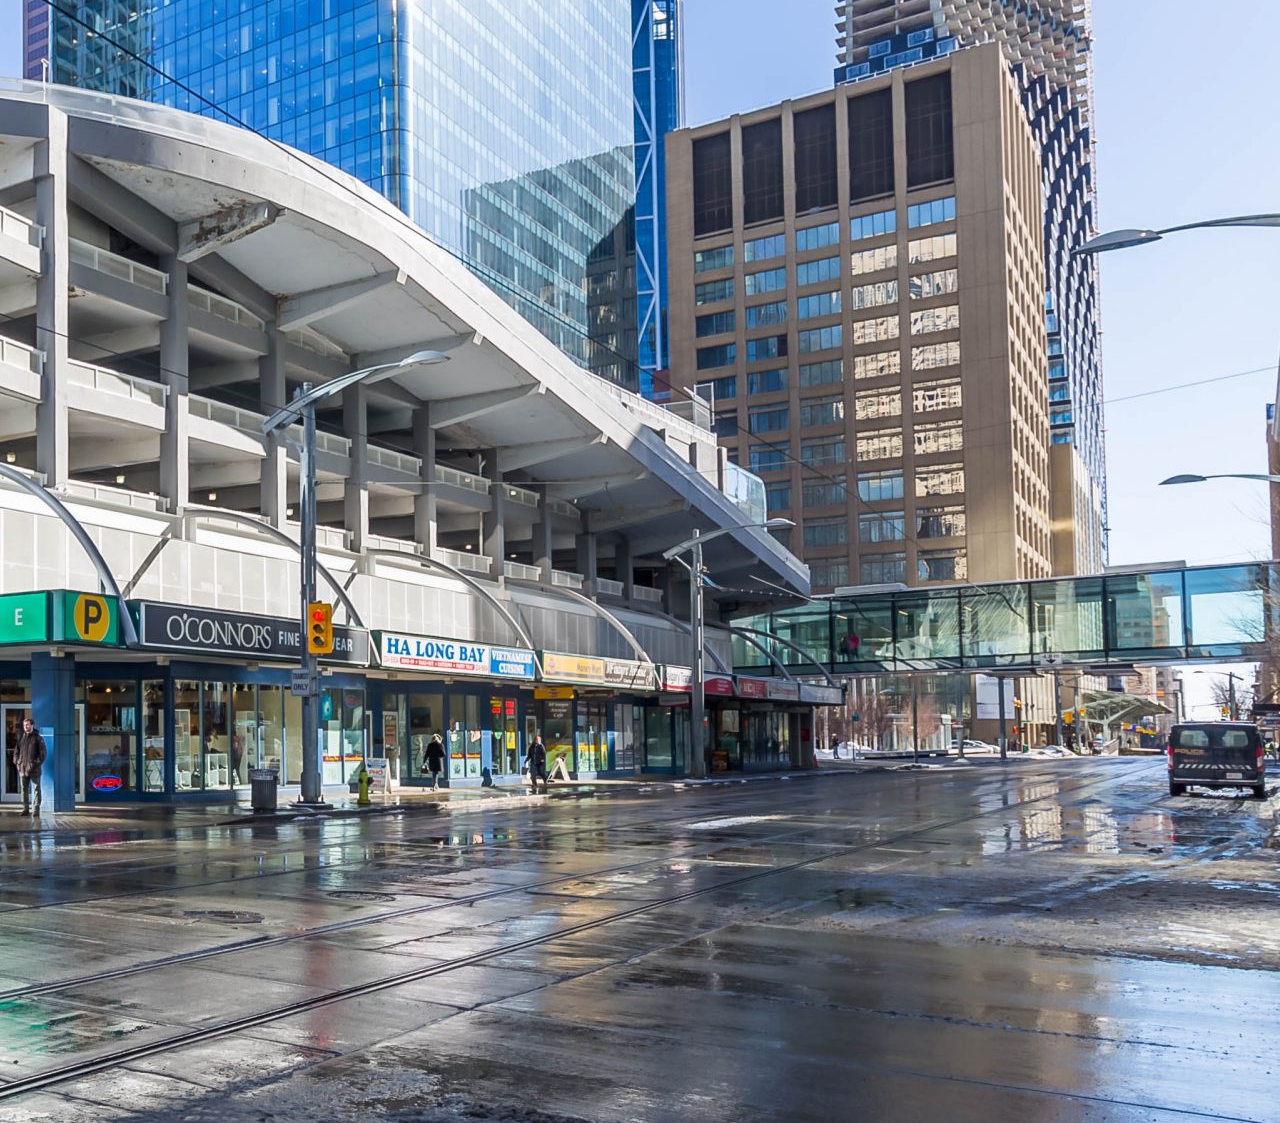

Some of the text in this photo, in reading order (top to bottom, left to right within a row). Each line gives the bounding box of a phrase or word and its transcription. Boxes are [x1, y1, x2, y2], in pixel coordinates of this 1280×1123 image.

[84, 598, 103, 635] P
[166, 612, 272, 649] O'CONNORS
[278, 630, 300, 647] FINE
[387, 637, 411, 656] HA
[416, 640, 455, 660] LONG
[459, 645, 486, 663] BAY
[491, 650, 532, 663] VIETNAMESE
[498, 663, 525, 675] CUISINE
[293, 683, 308, 691] ONLY
[93, 776, 122, 790] OPEN
